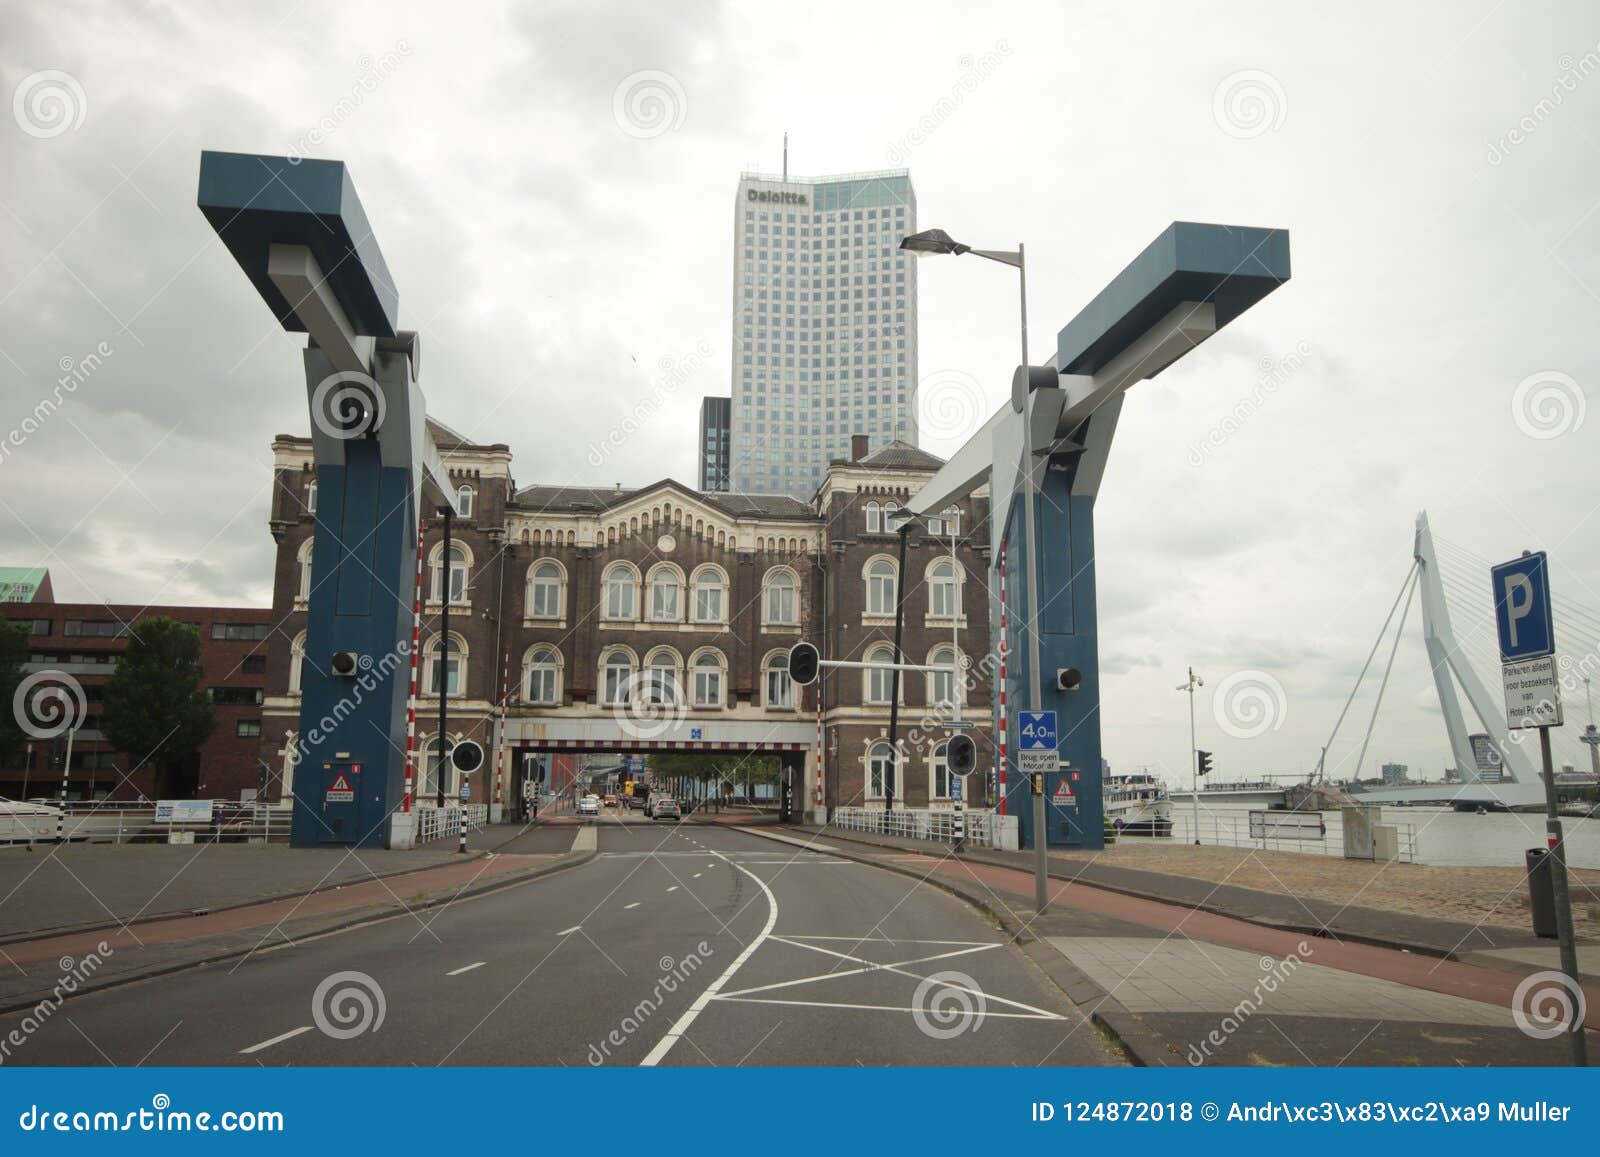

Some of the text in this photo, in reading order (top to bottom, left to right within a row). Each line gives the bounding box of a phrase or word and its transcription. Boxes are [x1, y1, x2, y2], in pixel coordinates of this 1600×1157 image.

[748, 188, 807, 206] Deloitte
[1504, 572, 1533, 648] P
[1531, 662, 1551, 673] alleen
[1506, 677, 1553, 690] voor bezoekers
[1522, 692, 1534, 701] van
[1510, 707, 1526, 717] Hotel
[1020, 753, 1057, 763] Brug open
[1023, 762, 1055, 770] Motor af
